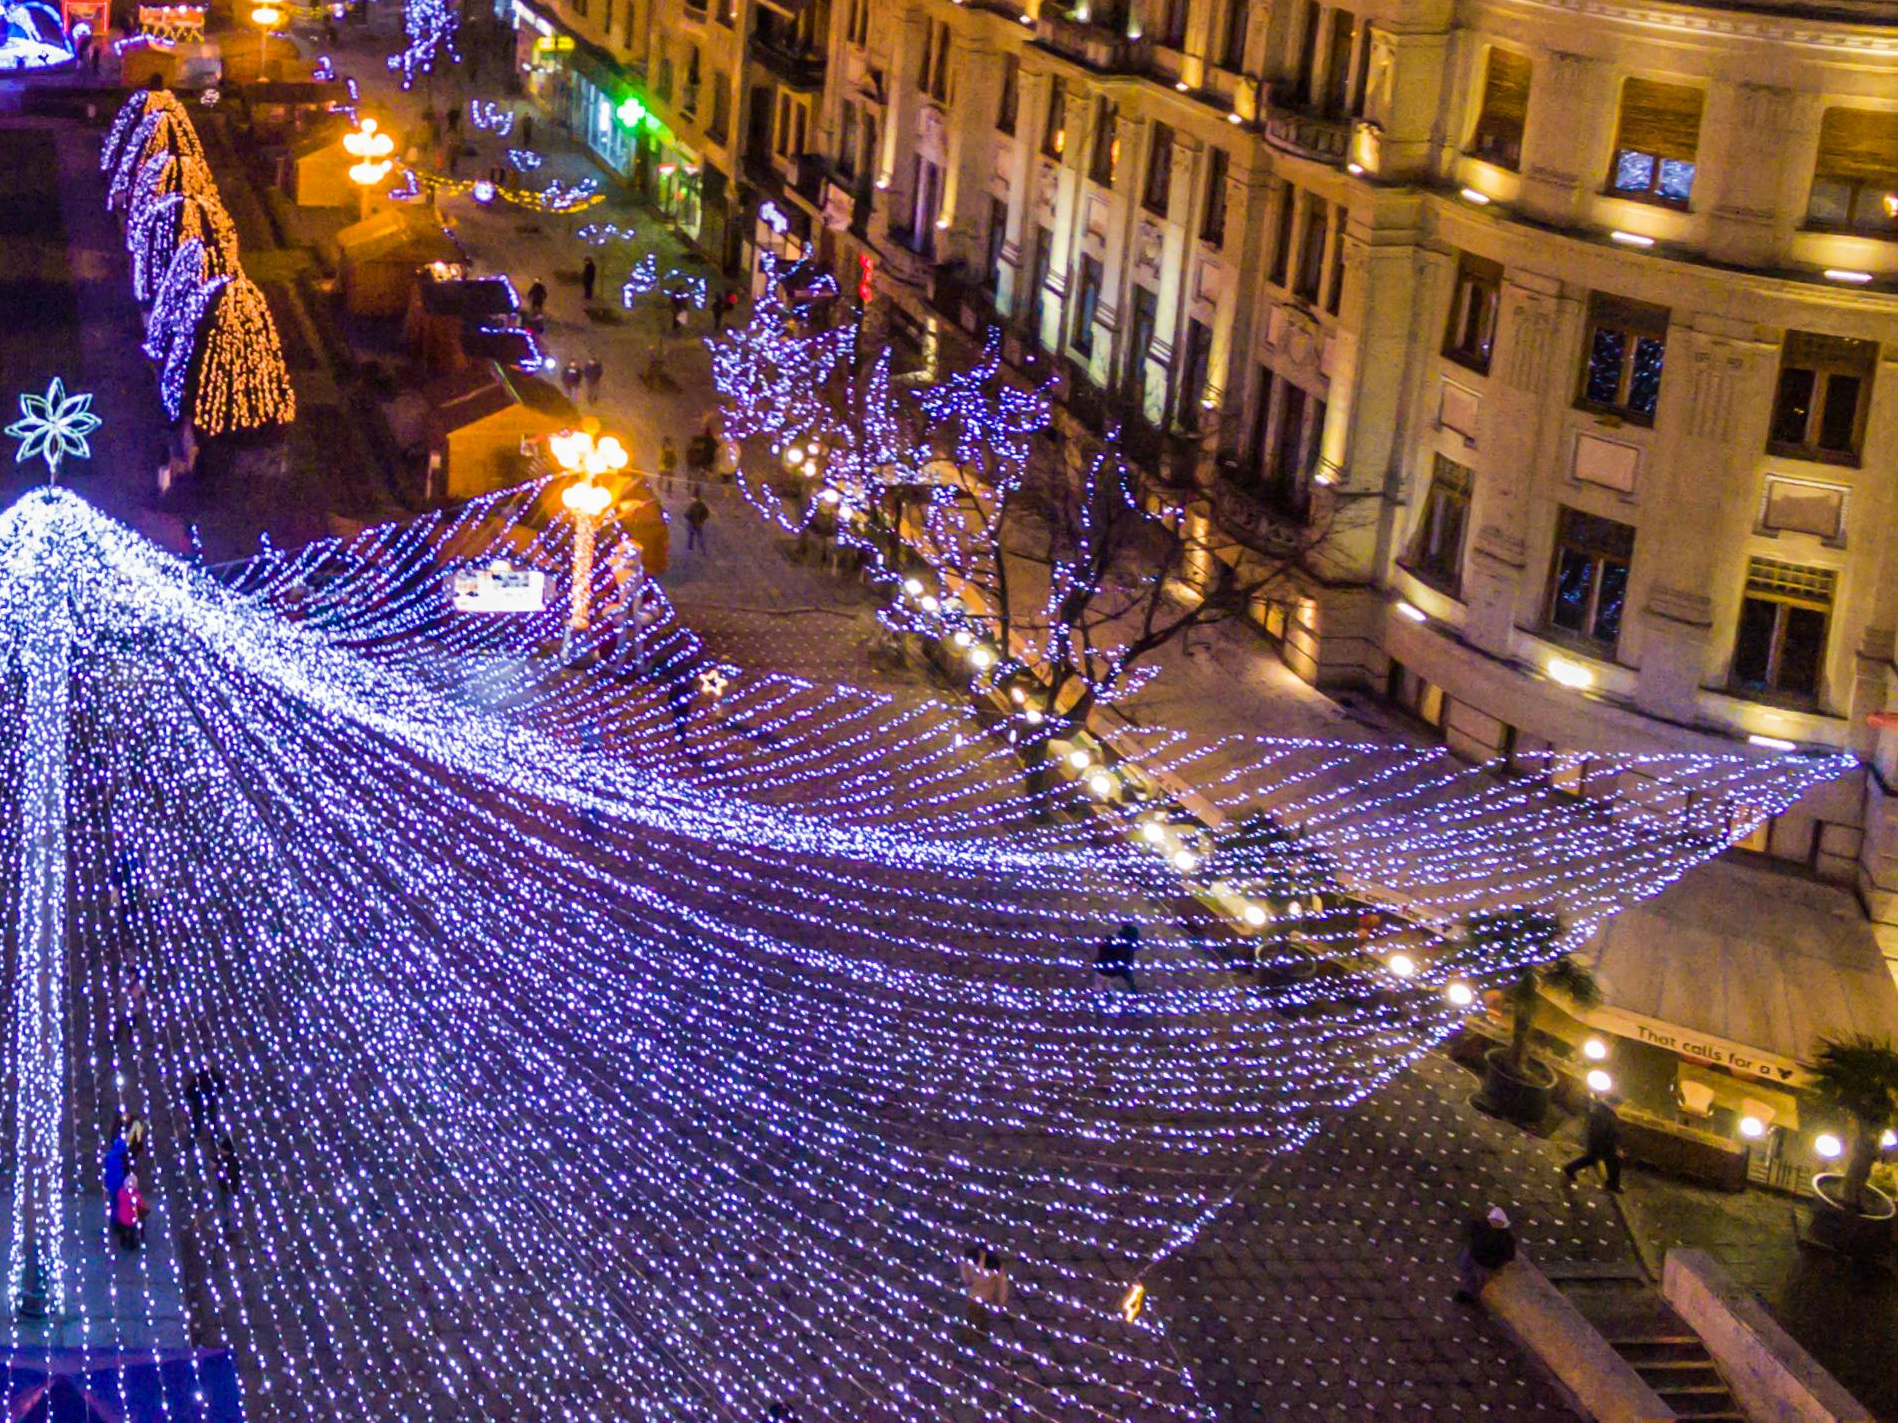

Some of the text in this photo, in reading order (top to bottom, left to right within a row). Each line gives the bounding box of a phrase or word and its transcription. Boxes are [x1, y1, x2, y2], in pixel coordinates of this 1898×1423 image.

[1637, 1025, 1770, 1075] That calls for a
